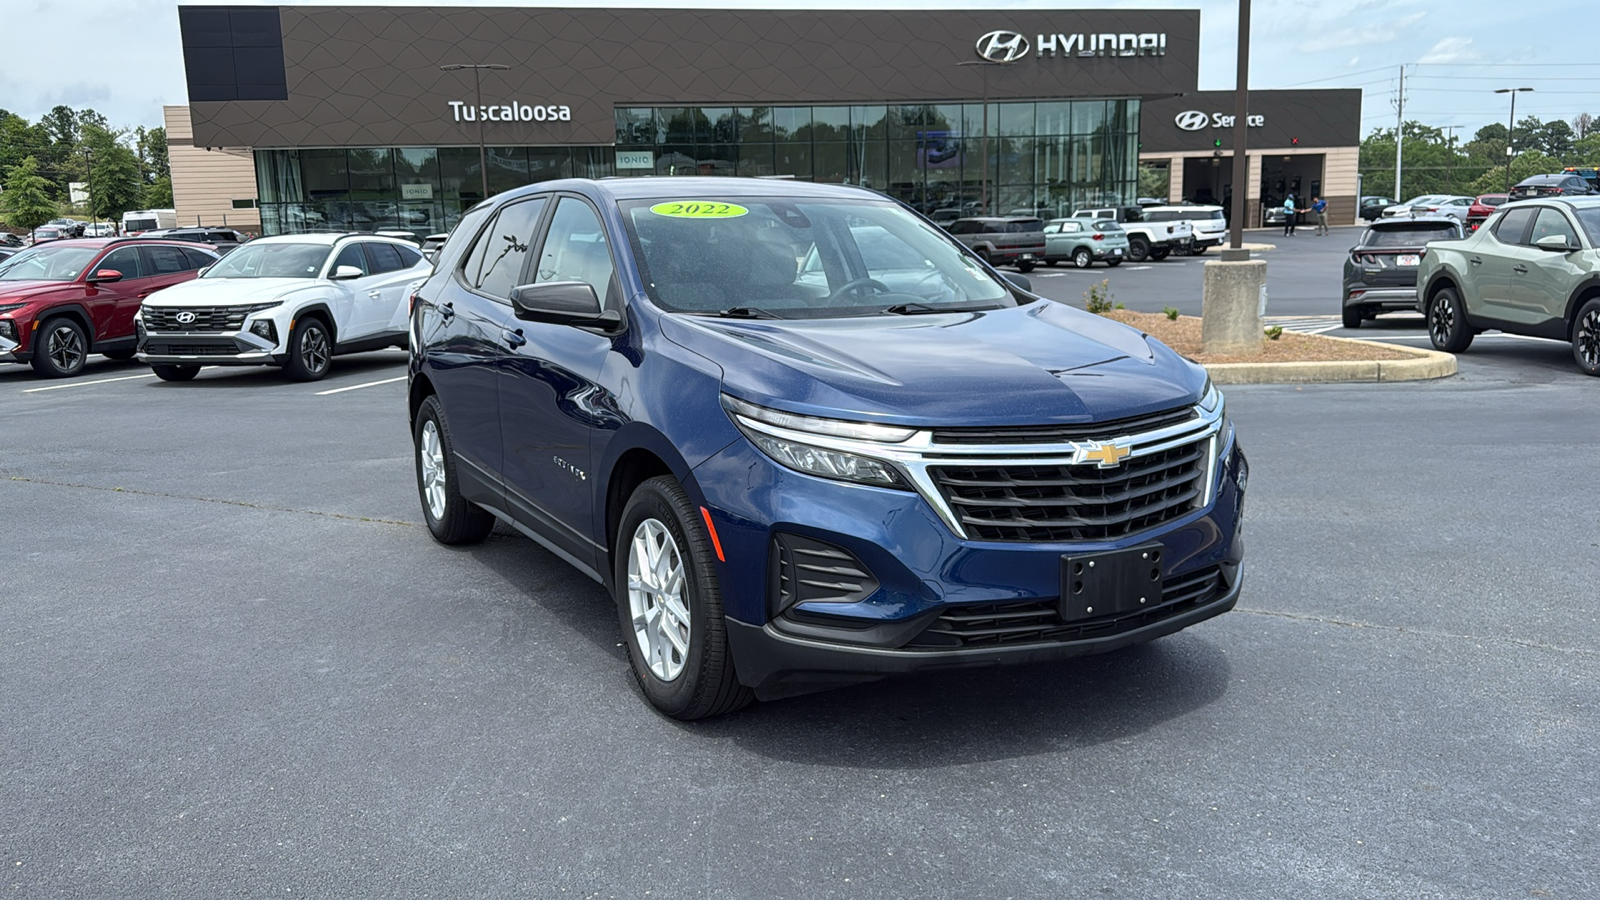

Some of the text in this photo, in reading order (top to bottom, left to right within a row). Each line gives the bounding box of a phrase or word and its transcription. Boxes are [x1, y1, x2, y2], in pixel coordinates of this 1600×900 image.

[1036, 33, 1167, 57] HYUNDAI
[448, 100, 571, 121] Tuscaloosa
[1211, 112, 1265, 128] Serce
[669, 204, 730, 214] 2022
